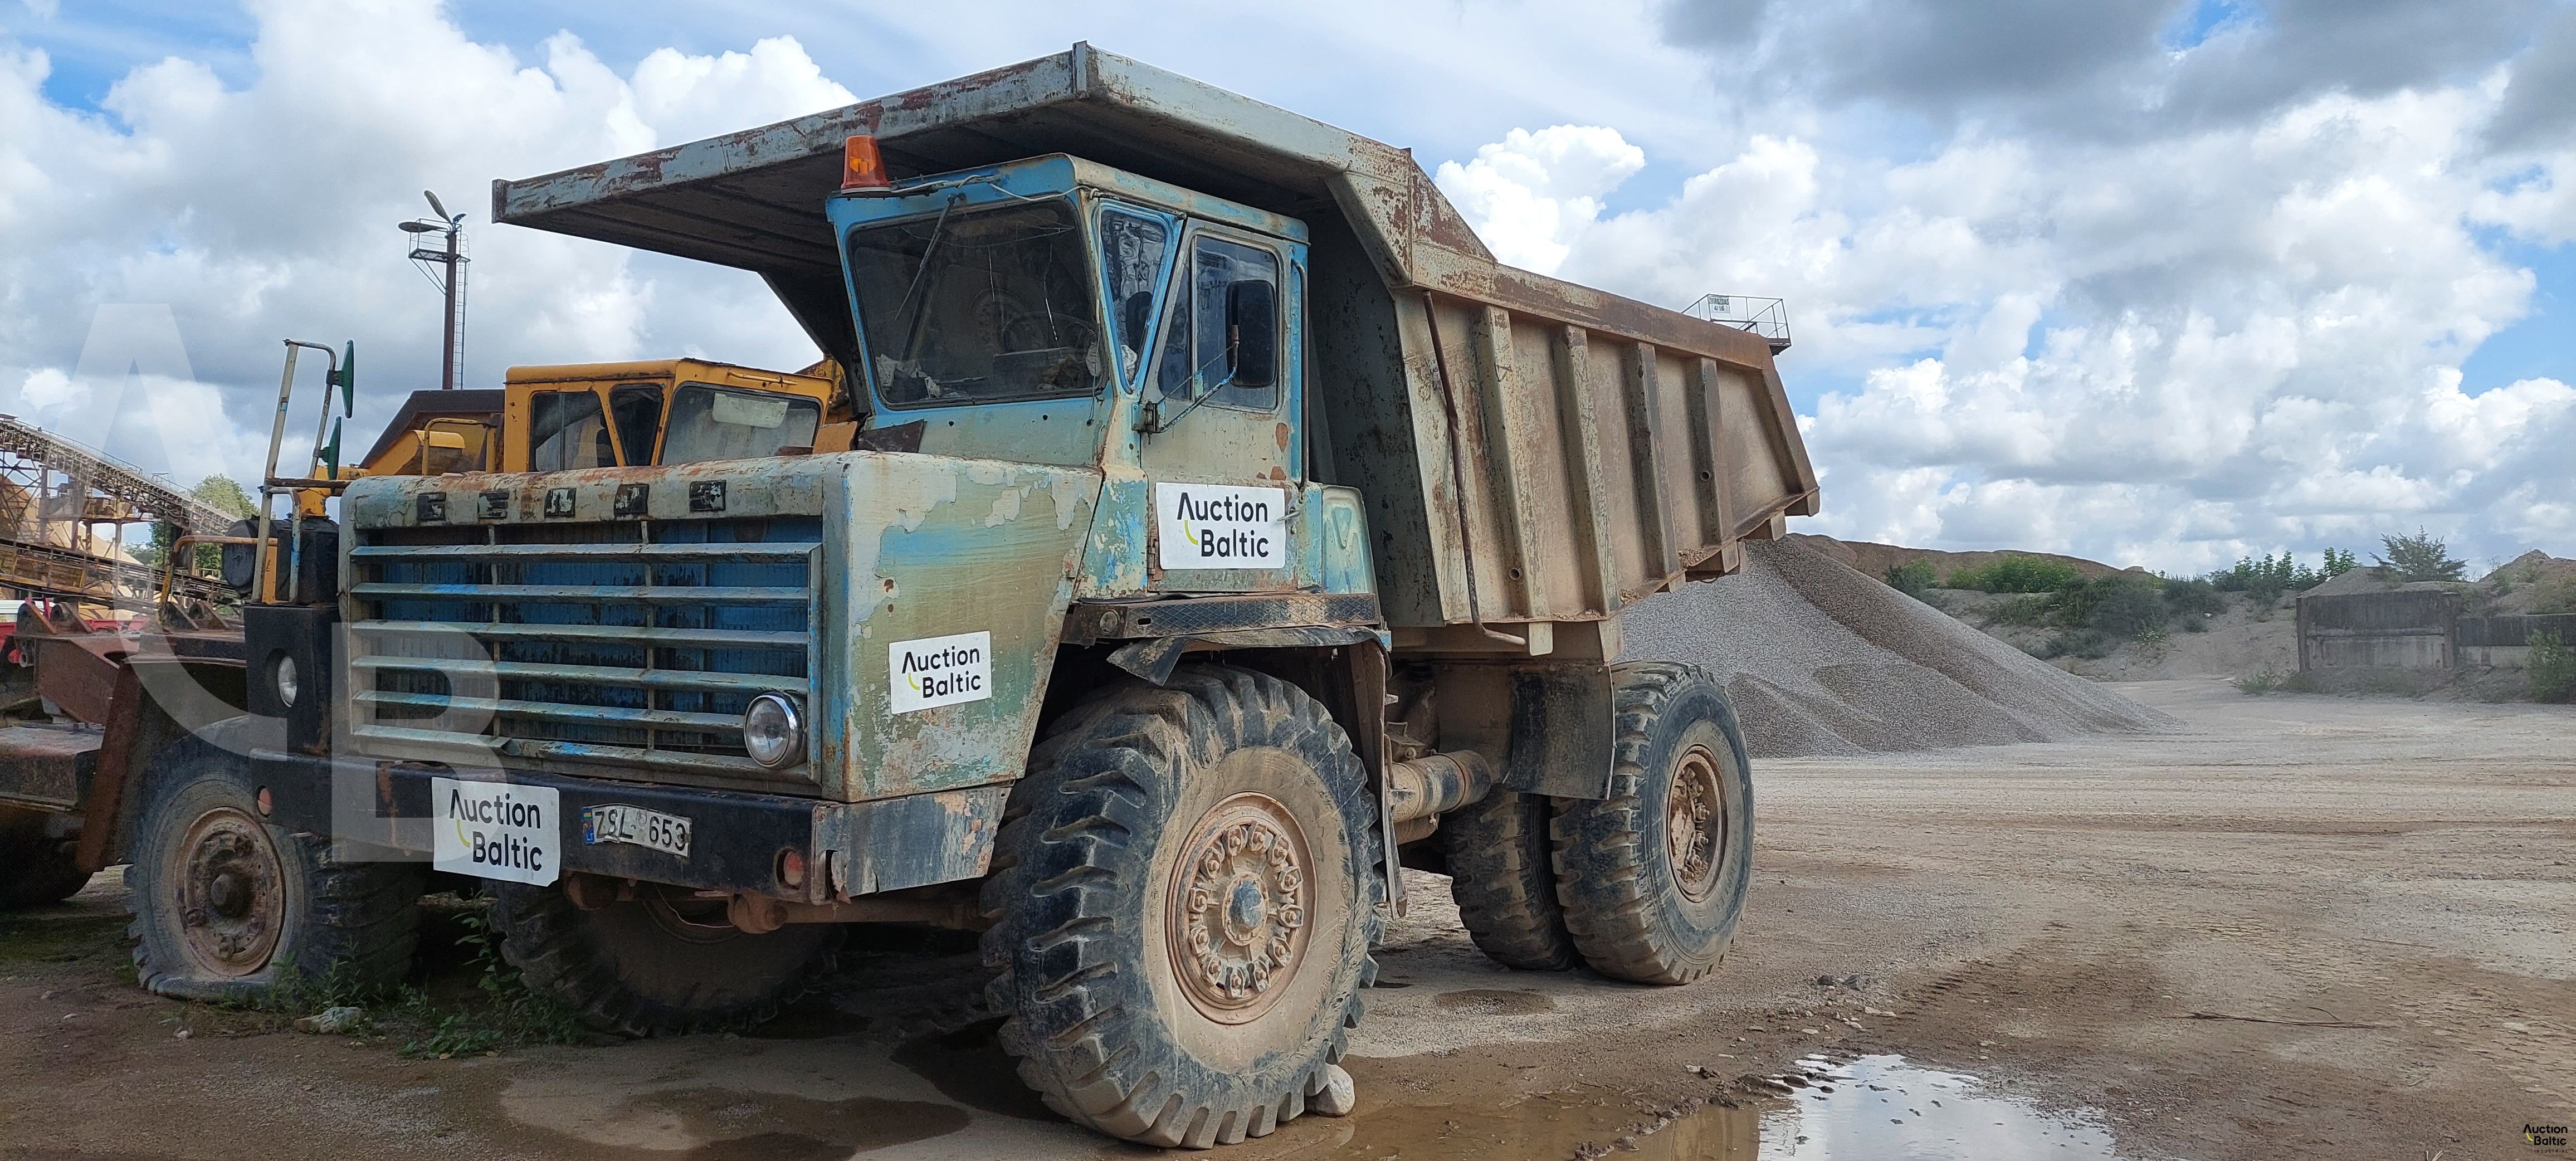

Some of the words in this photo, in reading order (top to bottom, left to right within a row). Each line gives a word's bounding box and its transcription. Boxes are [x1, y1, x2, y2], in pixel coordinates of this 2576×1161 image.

[1177, 492, 1268, 522] Auction
[1201, 529, 1269, 557] Baltic
[901, 646, 980, 674] Auction
[923, 671, 981, 698] Baltic
[449, 789, 540, 829] Auction
[650, 816, 689, 851] 653
[472, 831, 543, 871] Baltic
